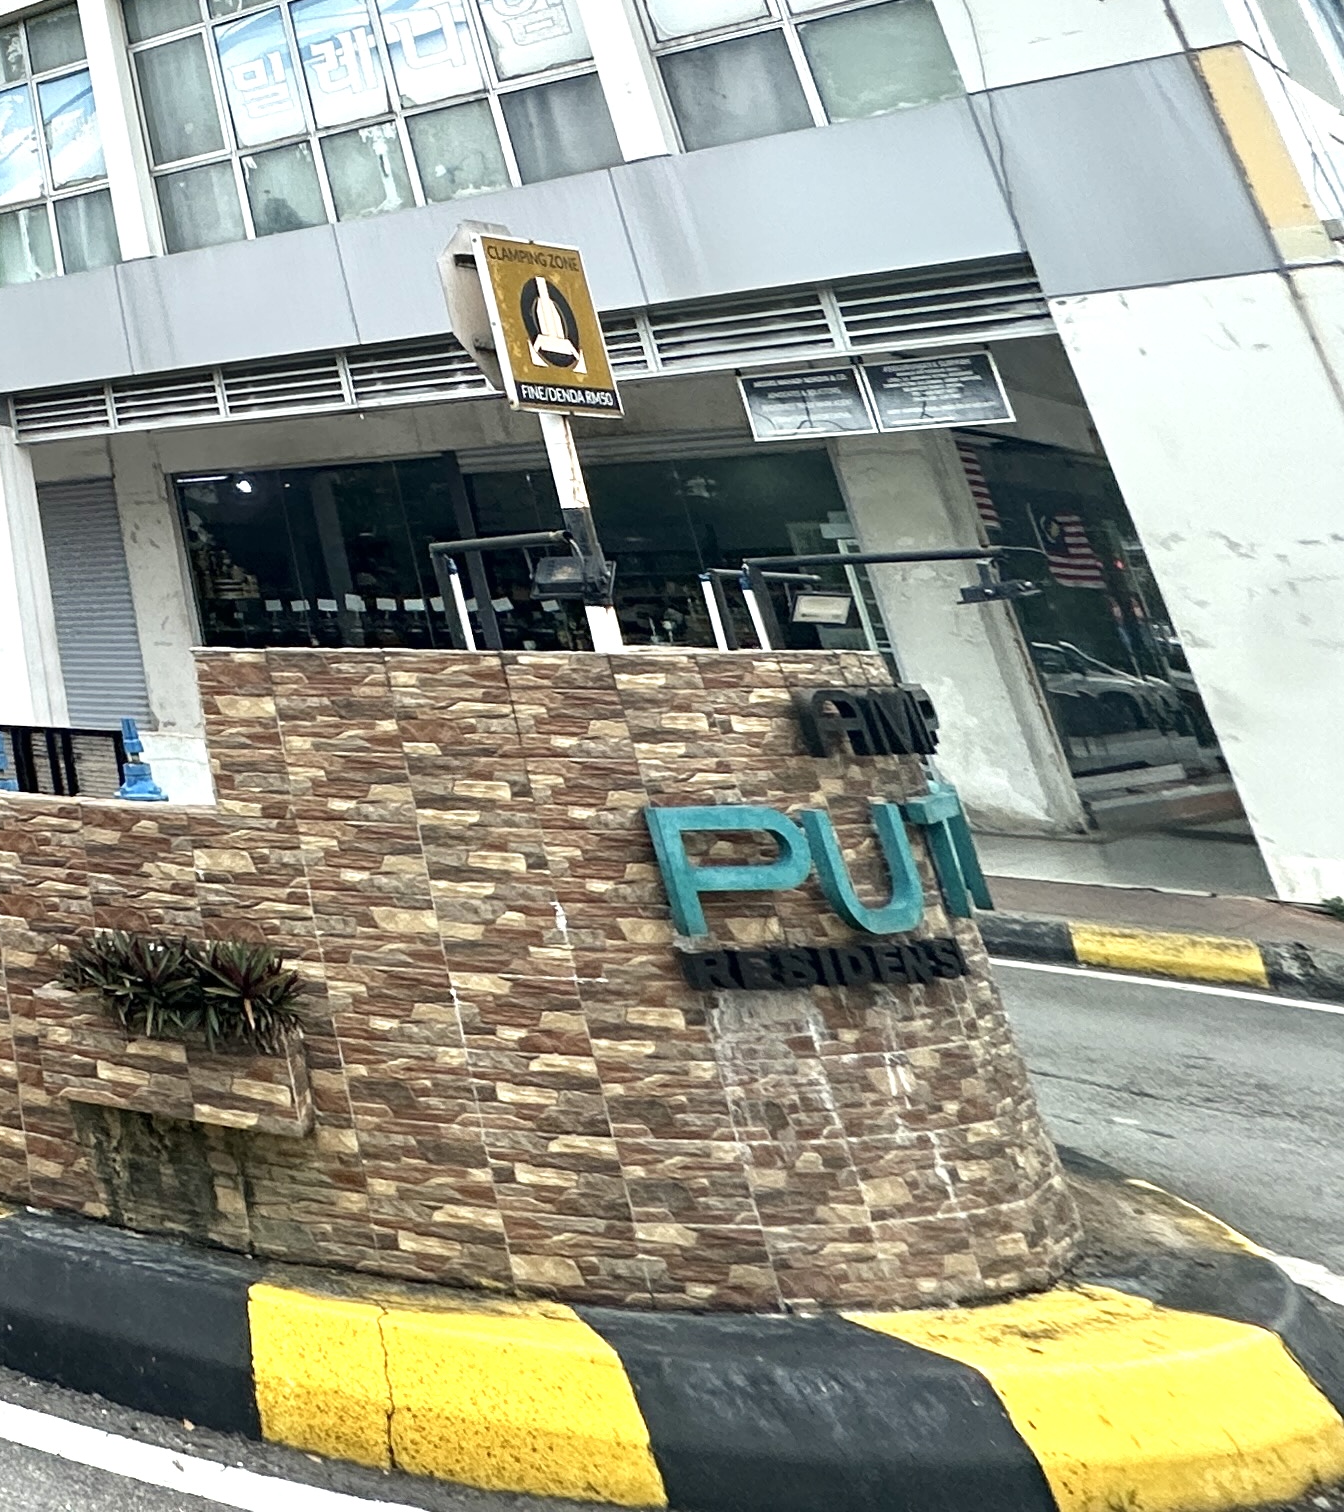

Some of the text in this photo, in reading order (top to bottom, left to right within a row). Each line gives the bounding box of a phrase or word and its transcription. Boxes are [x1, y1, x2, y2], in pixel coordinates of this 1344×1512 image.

[486, 245, 580, 273] CLAMPING ZONE
[520, 384, 614, 407] FINE/DENDA RM50
